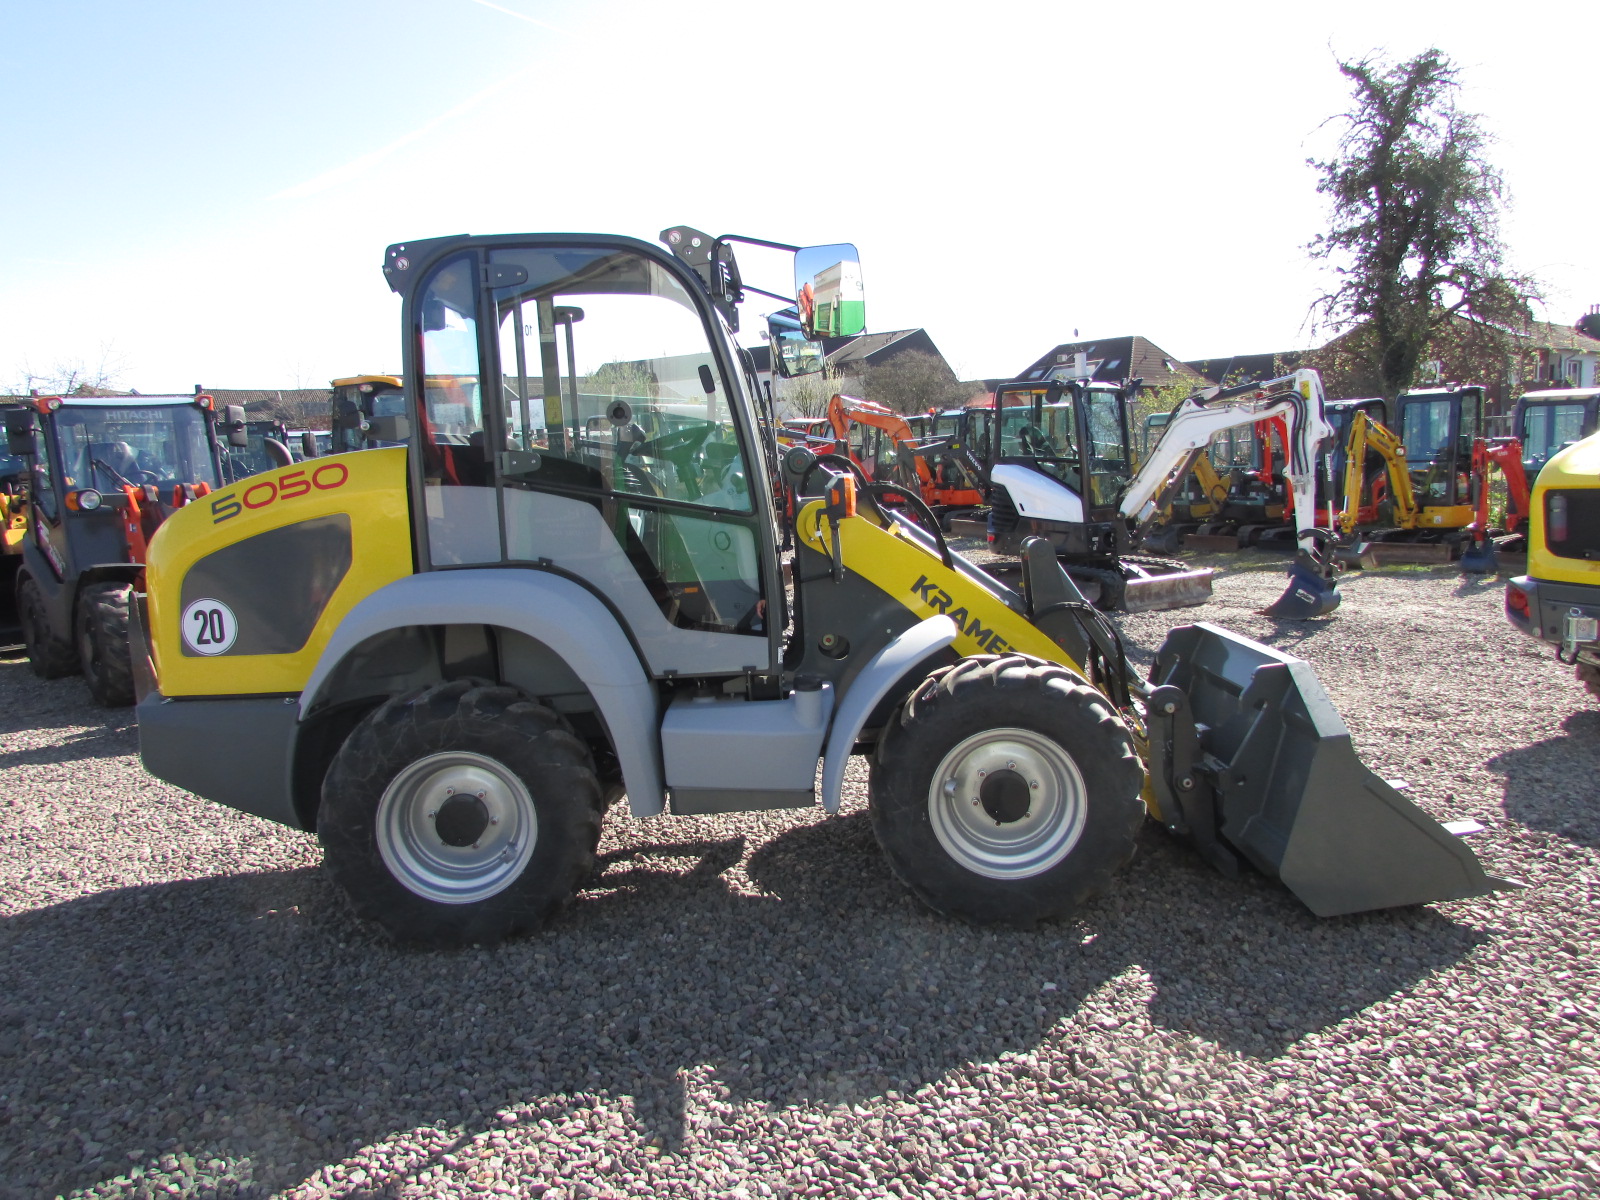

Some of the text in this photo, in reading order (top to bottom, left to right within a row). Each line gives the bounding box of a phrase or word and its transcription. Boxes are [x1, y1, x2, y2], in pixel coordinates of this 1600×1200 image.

[105, 410, 163, 420] HITACHI
[966, 450, 982, 471] VOLVO
[211, 463, 349, 524] 5050
[194, 609, 226, 645] 20
